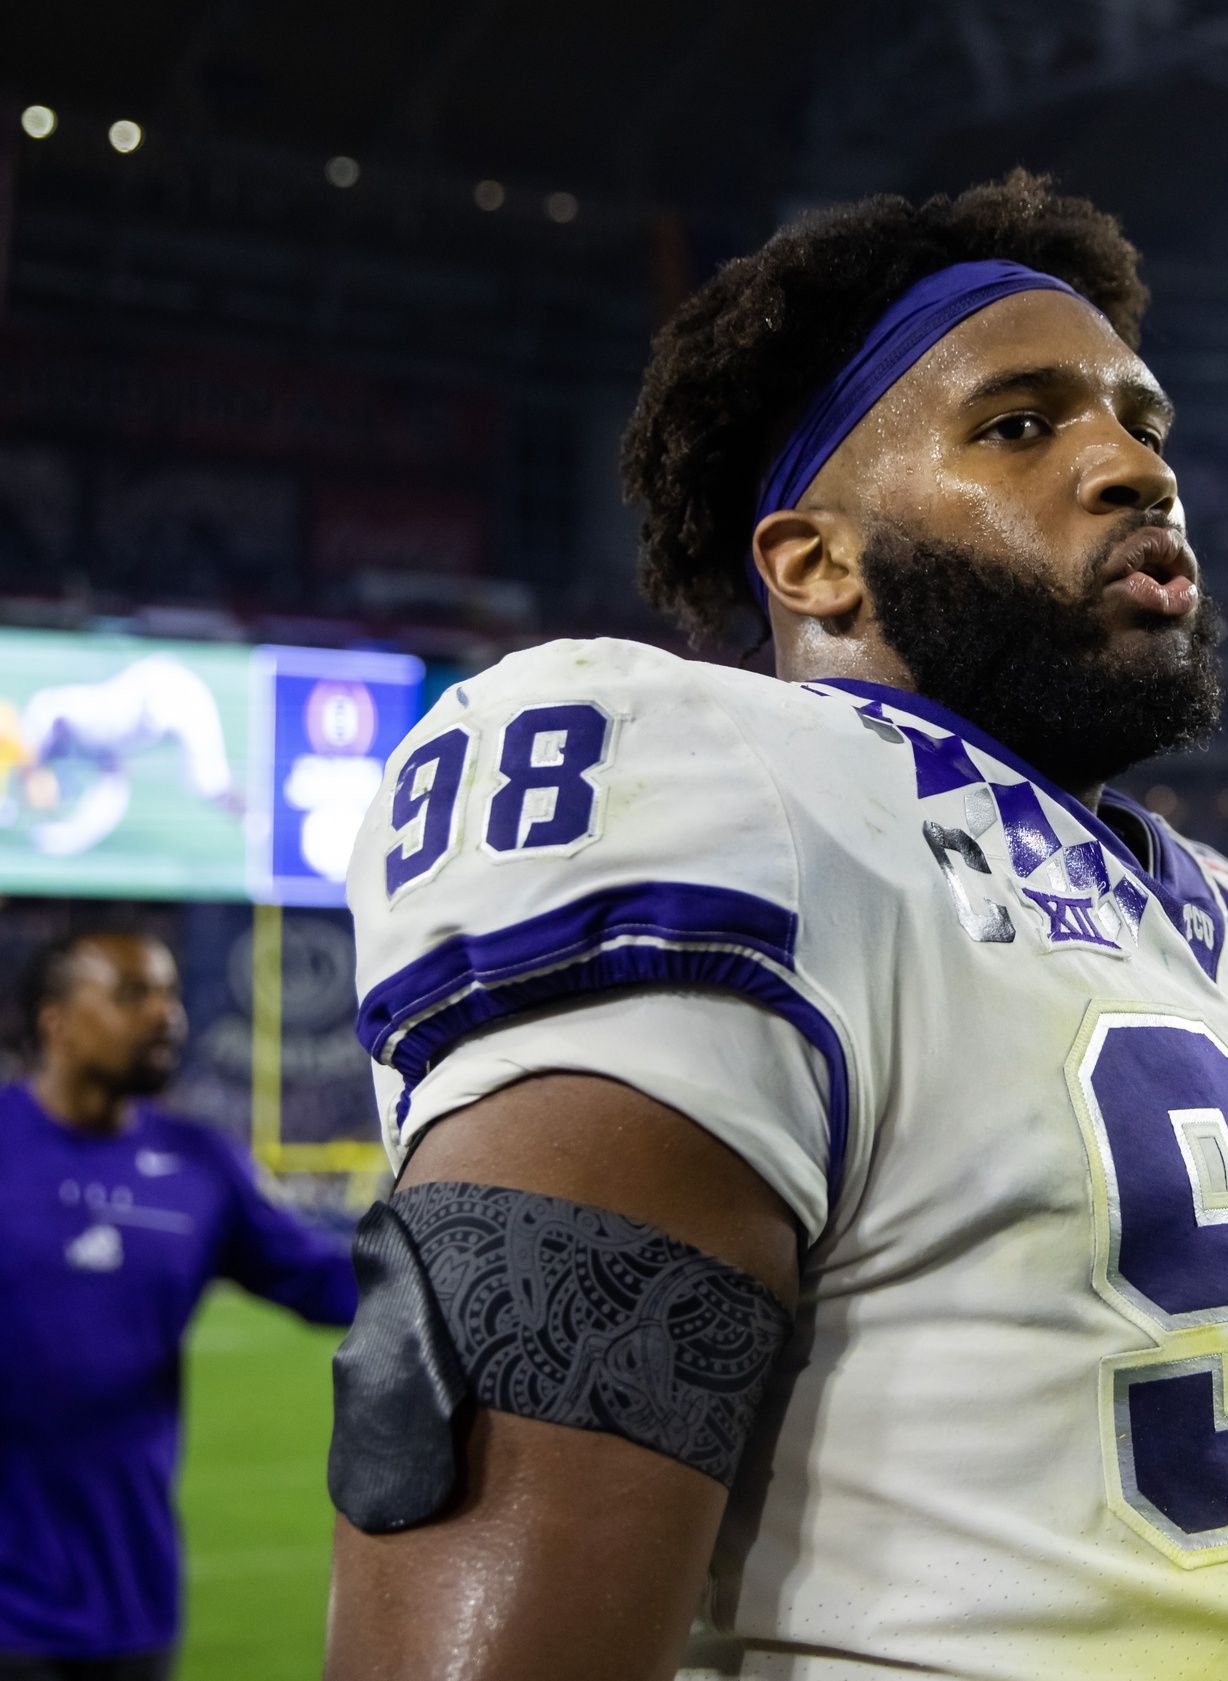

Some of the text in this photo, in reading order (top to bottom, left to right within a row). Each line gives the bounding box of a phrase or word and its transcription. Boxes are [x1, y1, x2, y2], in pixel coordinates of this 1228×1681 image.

[384, 700, 616, 902] 98
[1021, 887, 1122, 949] XII
[1182, 903, 1215, 951] TCU
